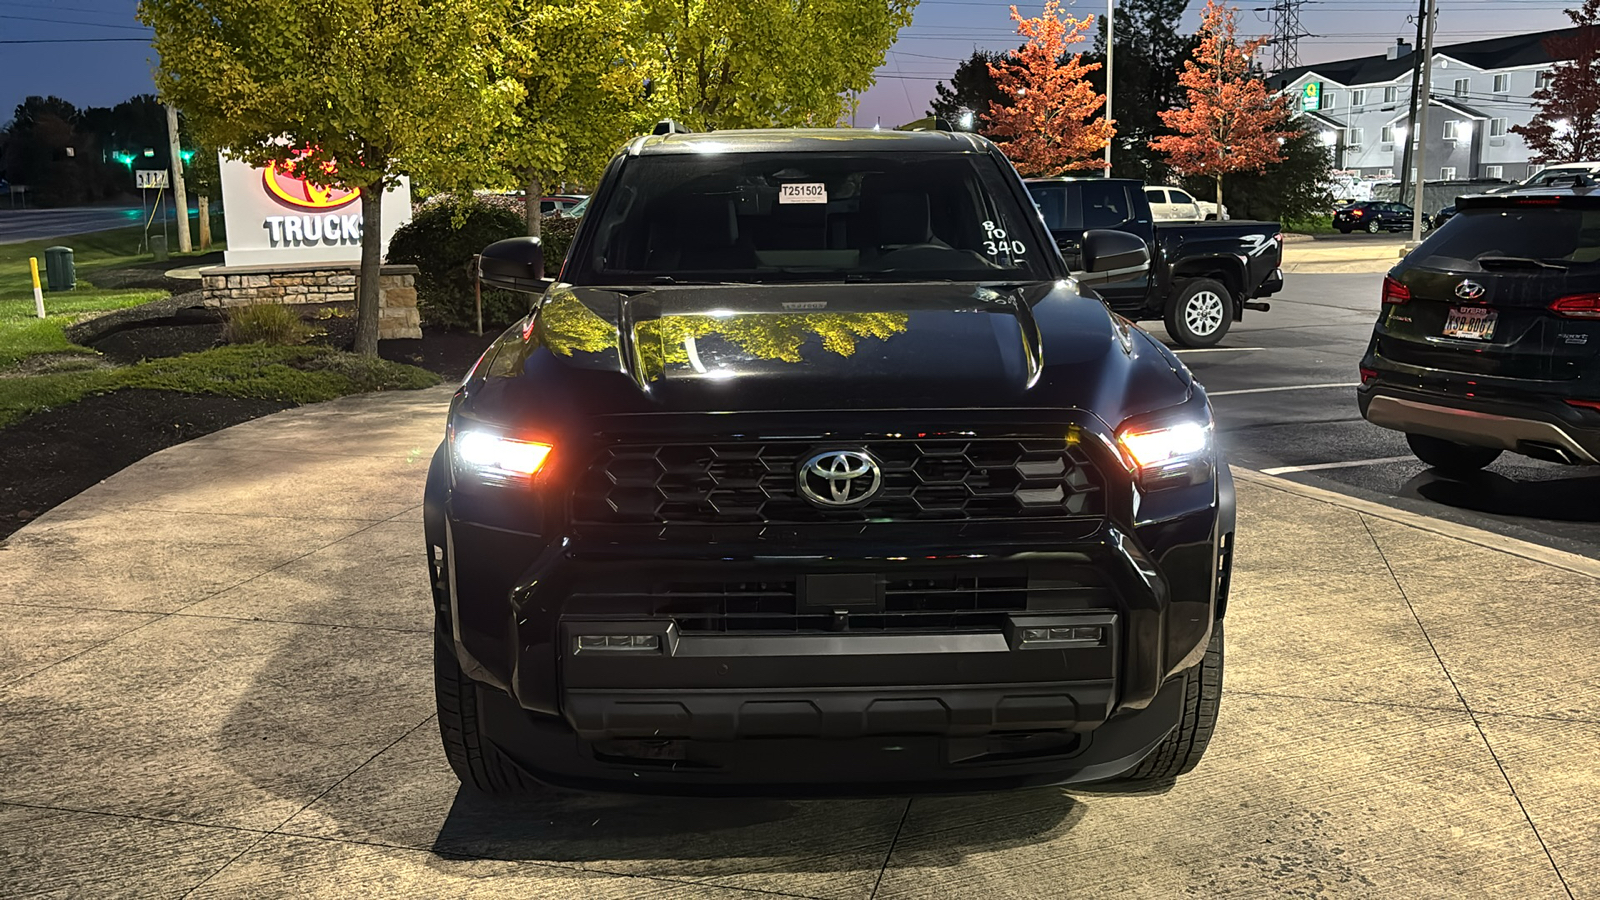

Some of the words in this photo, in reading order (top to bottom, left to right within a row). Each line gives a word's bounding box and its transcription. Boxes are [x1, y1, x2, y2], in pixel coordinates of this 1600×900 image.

[782, 185, 823, 196] T251502
[265, 214, 364, 241] TRUCK
[987, 228, 1007, 239] 10
[982, 240, 1026, 255] 340
